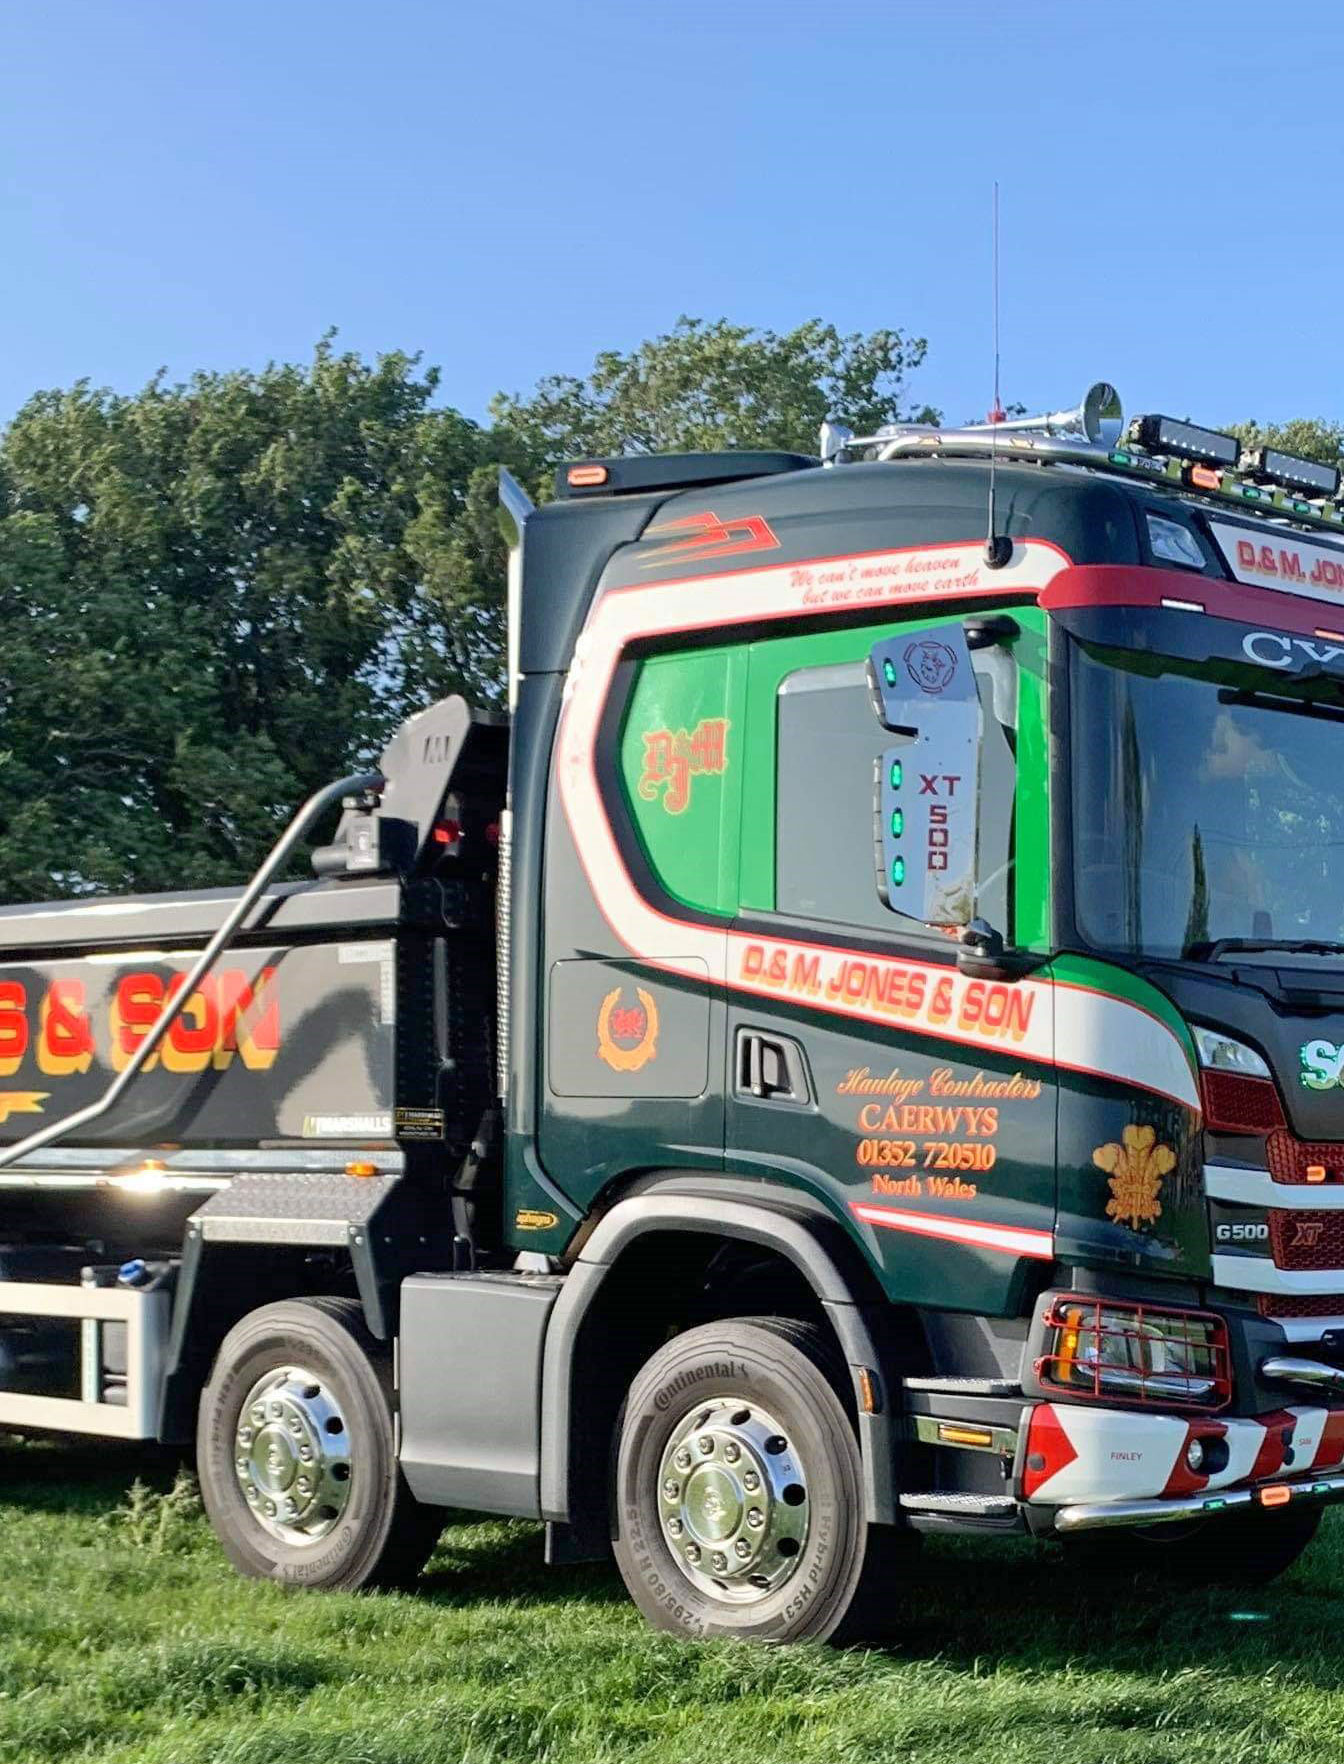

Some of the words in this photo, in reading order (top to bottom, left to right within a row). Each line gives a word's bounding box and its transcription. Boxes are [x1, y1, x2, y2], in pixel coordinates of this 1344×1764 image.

[789, 570, 813, 587] We
[818, 563, 857, 585] can't
[860, 566, 899, 578] move
[906, 556, 960, 575] heaven
[801, 586, 827, 604] but
[832, 588, 850, 600] we
[856, 585, 883, 599] can
[889, 581, 929, 594] move
[934, 569, 980, 590] earth
[919, 774, 960, 796] XT
[825, 960, 927, 1018] JONES
[928, 976, 953, 1025] &
[958, 982, 1035, 1042] SON
[37, 977, 95, 1073] &
[110, 966, 281, 1073] SON
[836, 1067, 924, 1106] Haulage
[929, 1068, 1042, 1099] Contractors
[859, 1103, 998, 1137] CAERWYS
[856, 1138, 916, 1167] 01352
[923, 1142, 996, 1171] 720510
[872, 1174, 921, 1196] North
[926, 1176, 977, 1199] Wales
[1216, 1224, 1268, 1240] G500
[1291, 1223, 1323, 1245] XT
[654, 1361, 735, 1412] Continental
[1111, 1452, 1143, 1461] FINLEY
